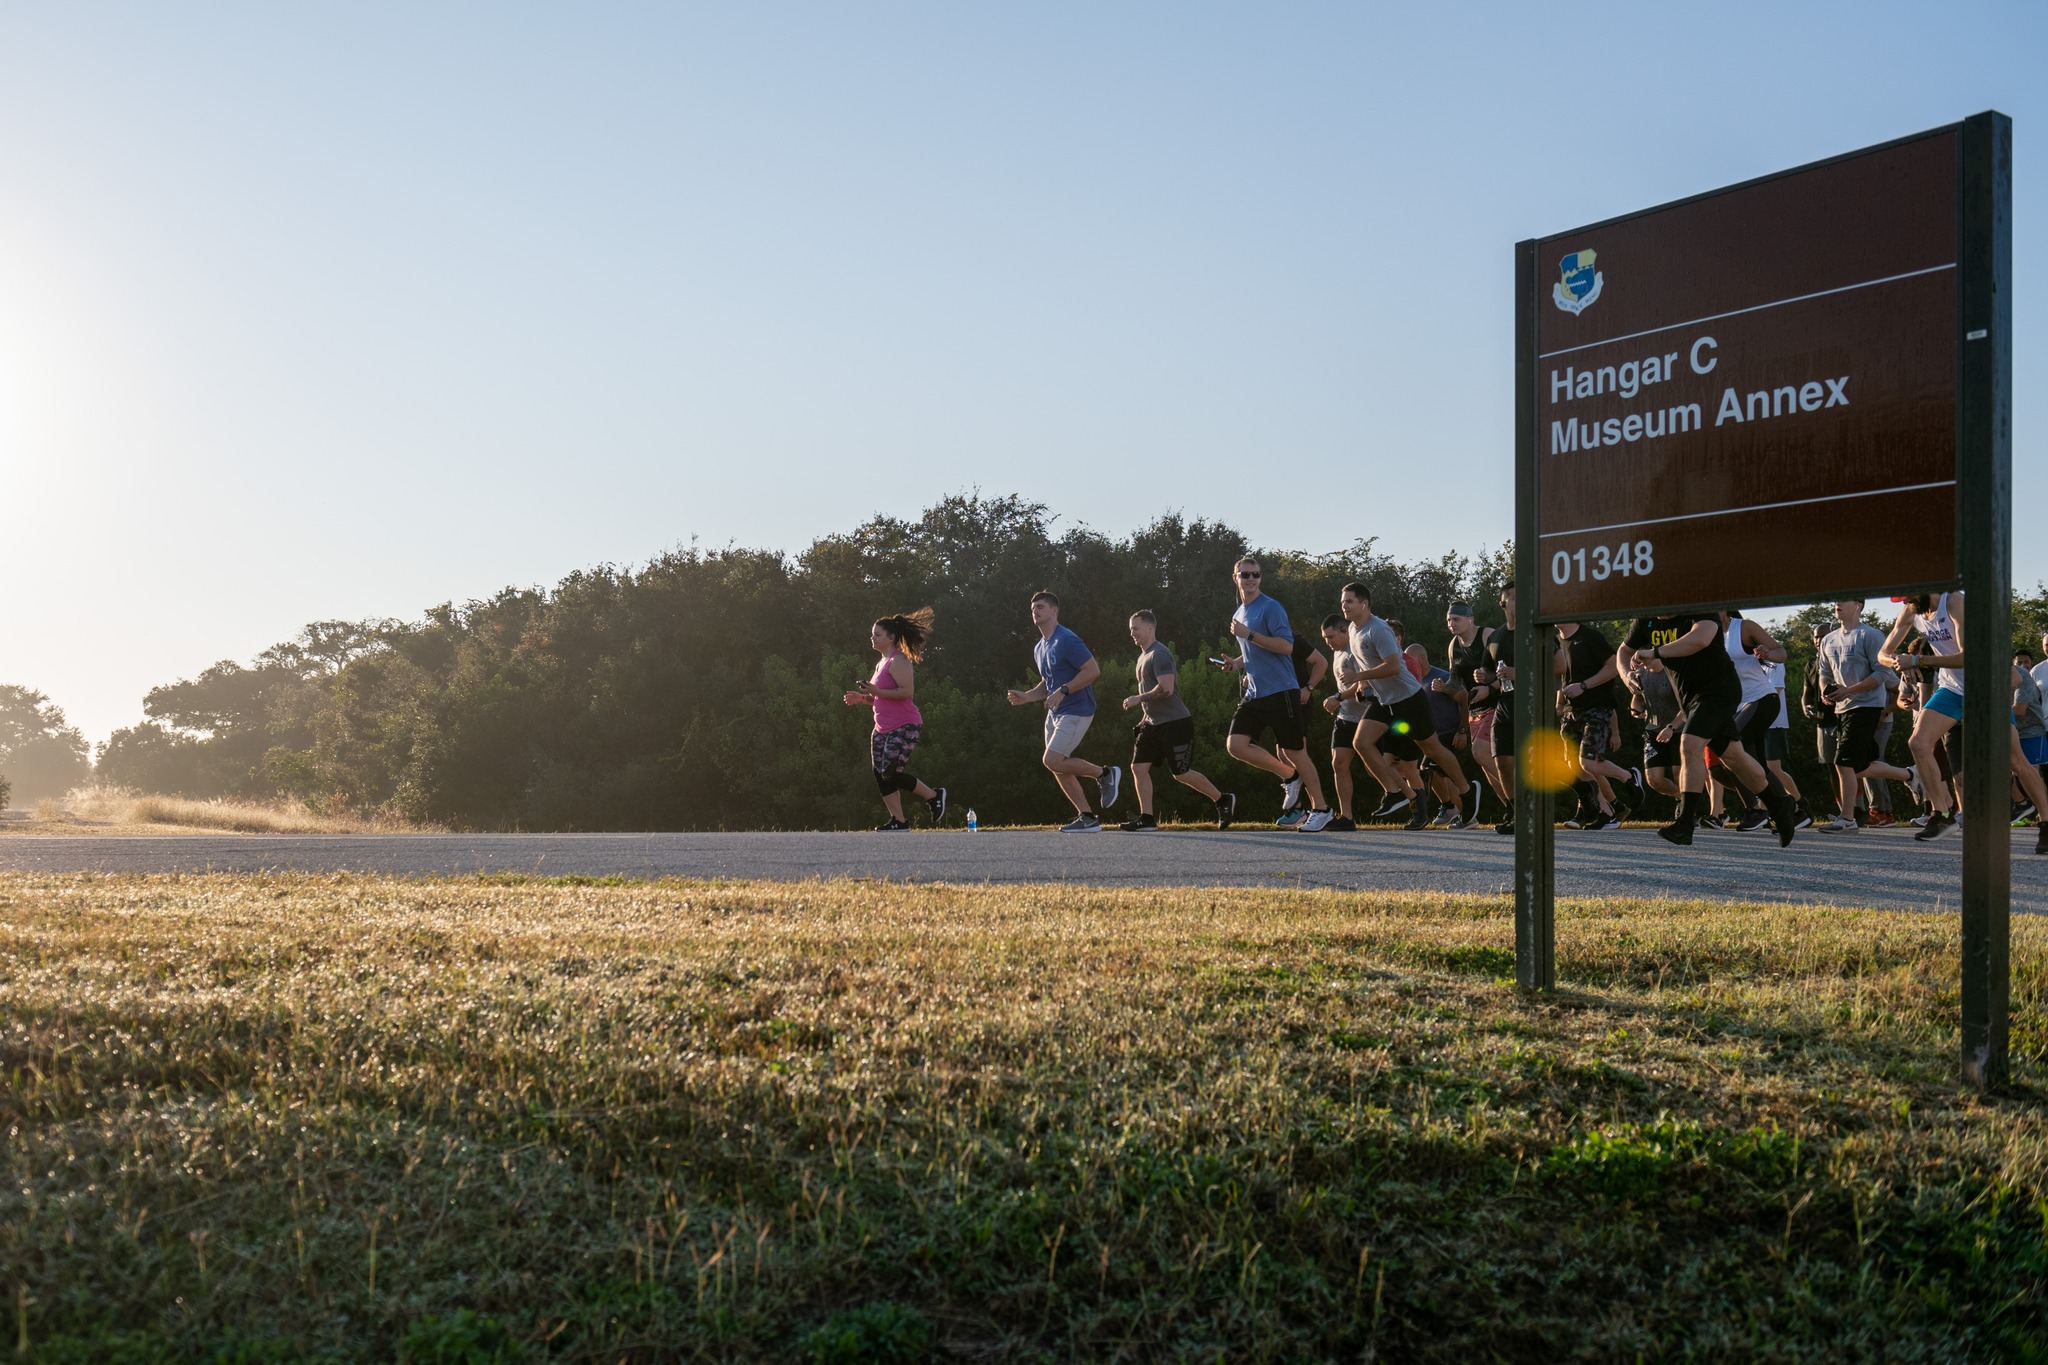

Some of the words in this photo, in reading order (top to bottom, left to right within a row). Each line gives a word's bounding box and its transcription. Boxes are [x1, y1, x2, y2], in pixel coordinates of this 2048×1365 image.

[1551, 352, 1678, 403] Hangar
[1690, 336, 1718, 375] C
[1551, 403, 1702, 455] Museum
[1715, 376, 1850, 427] Annex
[1551, 540, 1654, 585] 01348
[1651, 627, 1677, 646] GYM
